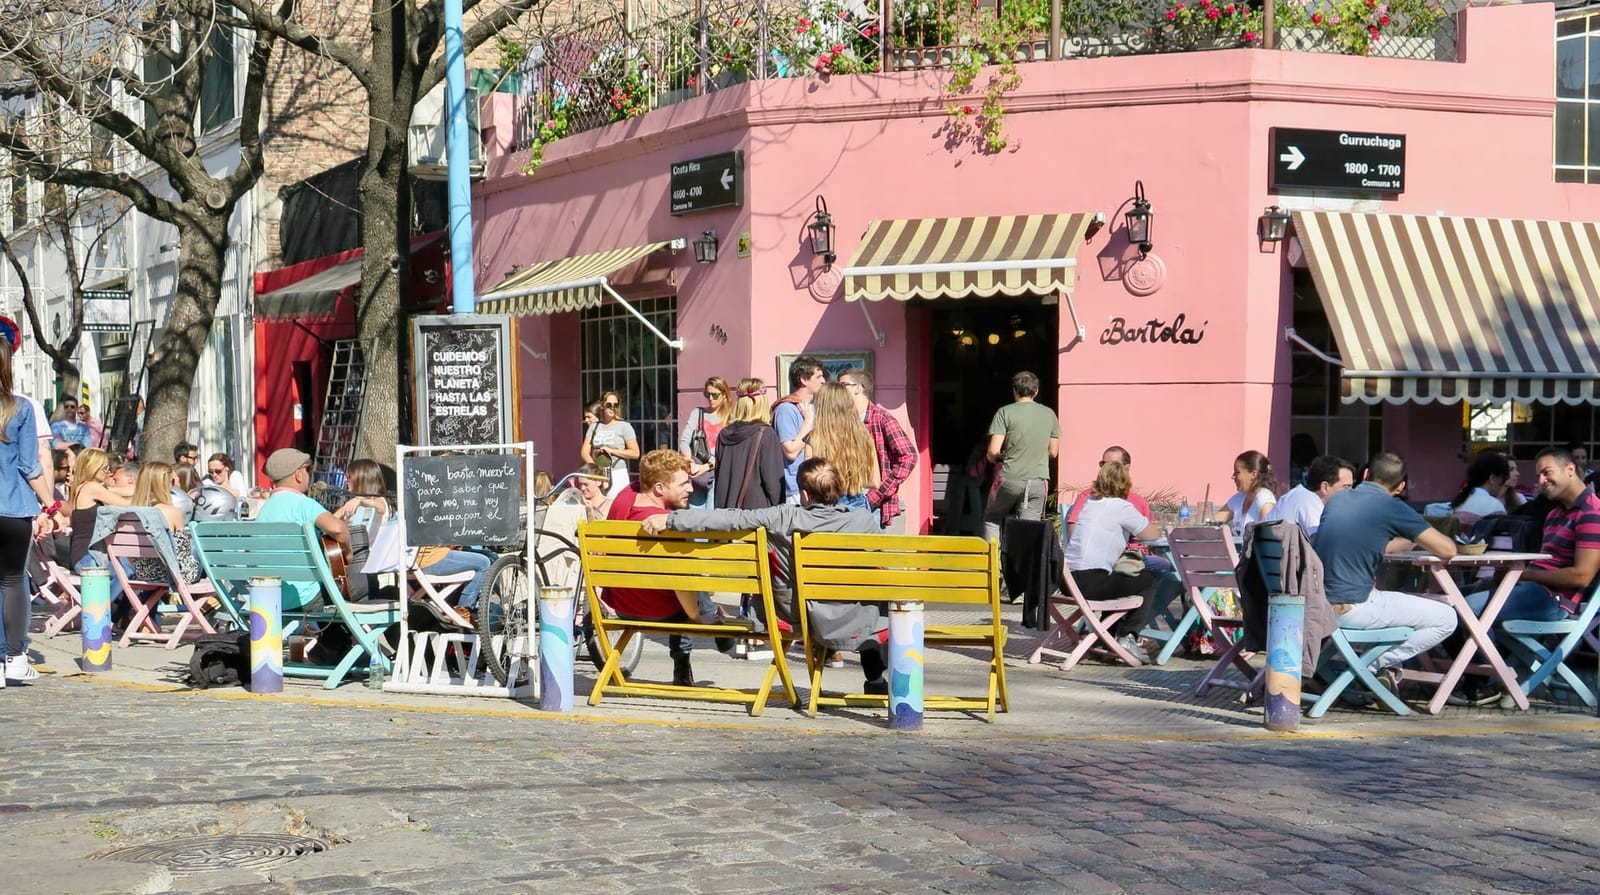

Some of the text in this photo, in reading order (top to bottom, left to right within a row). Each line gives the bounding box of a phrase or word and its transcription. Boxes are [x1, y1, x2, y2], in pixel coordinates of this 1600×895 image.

[1339, 133, 1401, 149] Gurruchaga
[672, 162, 700, 175] Costa Rica
[1344, 162, 1368, 174] 1800
[1378, 164, 1401, 176] 1700
[1361, 178, 1400, 188] Comuna 14
[689, 185, 702, 197] 4700
[1099, 313, 1208, 345] Bartola
[433, 351, 486, 362] CUIDEMOS
[433, 365, 481, 375] NUESTRO
[434, 378, 480, 389] PLANETA
[435, 392, 491, 402] HASTA LAS
[447, 465, 475, 480] basta
[417, 482, 508, 501] para saber que
[419, 500, 438, 509] con
[463, 498, 478, 507] me
[484, 496, 499, 508] voy
[417, 508, 502, 528] a empapar el
